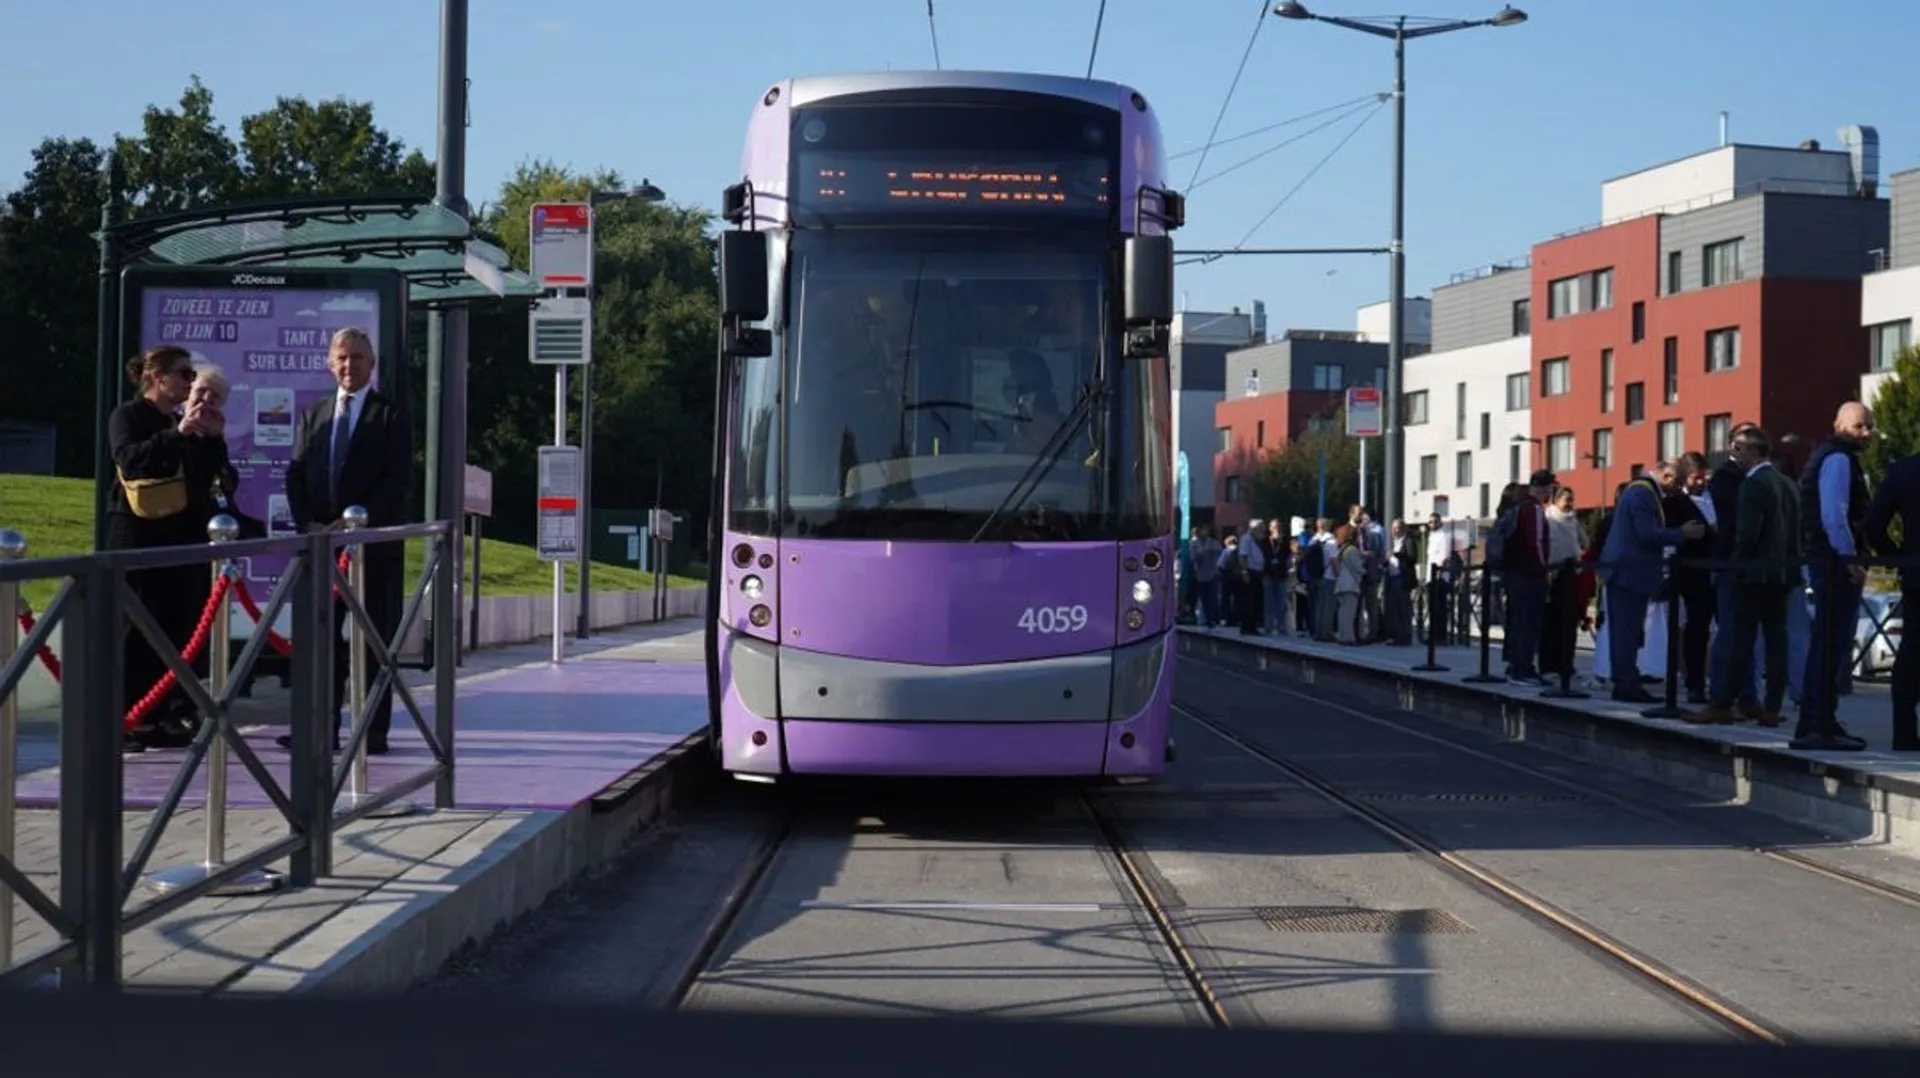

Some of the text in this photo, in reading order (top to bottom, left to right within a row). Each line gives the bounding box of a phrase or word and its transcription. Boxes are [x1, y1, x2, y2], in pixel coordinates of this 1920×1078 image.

[232, 274, 286, 285] JCDecaux
[162, 298, 270, 316] ZOVEEL TE ZIEN
[162, 323, 236, 340] OP LIJN 10
[283, 330, 316, 346] TANT
[248, 353, 276, 370] SUR
[280, 354, 297, 370] LA
[1016, 604, 1088, 634] 4059
